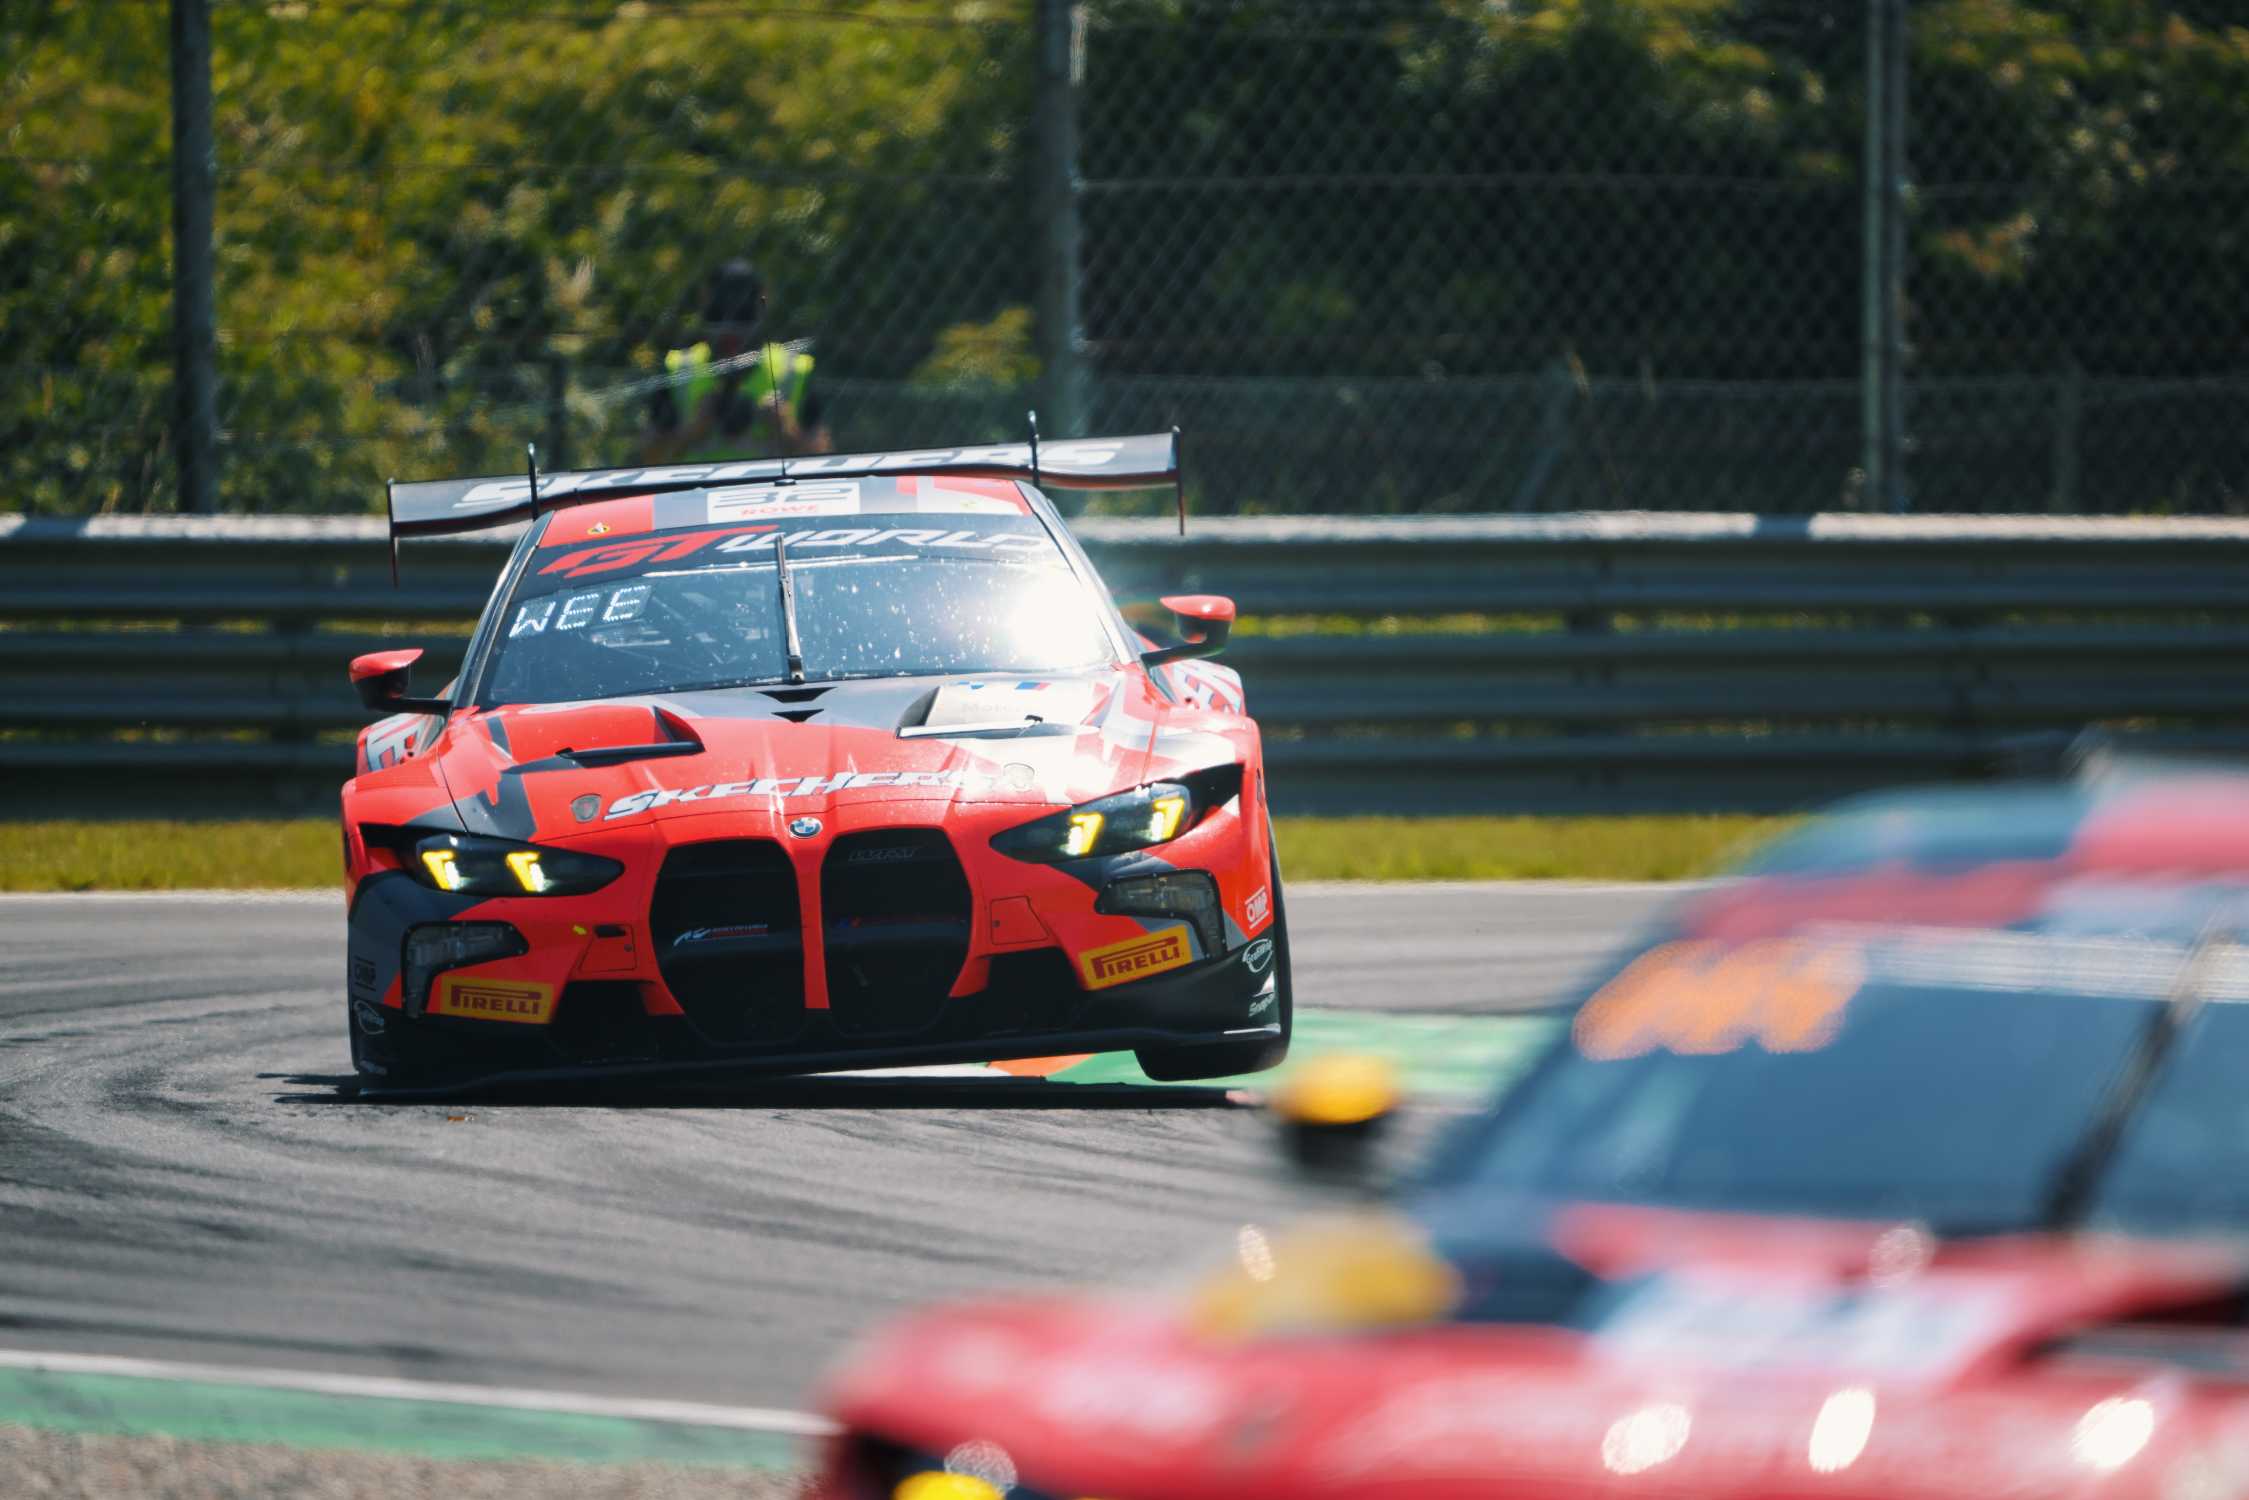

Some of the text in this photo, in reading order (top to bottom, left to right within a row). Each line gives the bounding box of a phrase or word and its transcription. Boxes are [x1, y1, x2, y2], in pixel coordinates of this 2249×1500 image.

[537, 524, 780, 578] GT
[509, 585, 651, 639] WEE
[1090, 936, 1180, 980] PIRELLI
[450, 984, 543, 1016] PIRELLI
